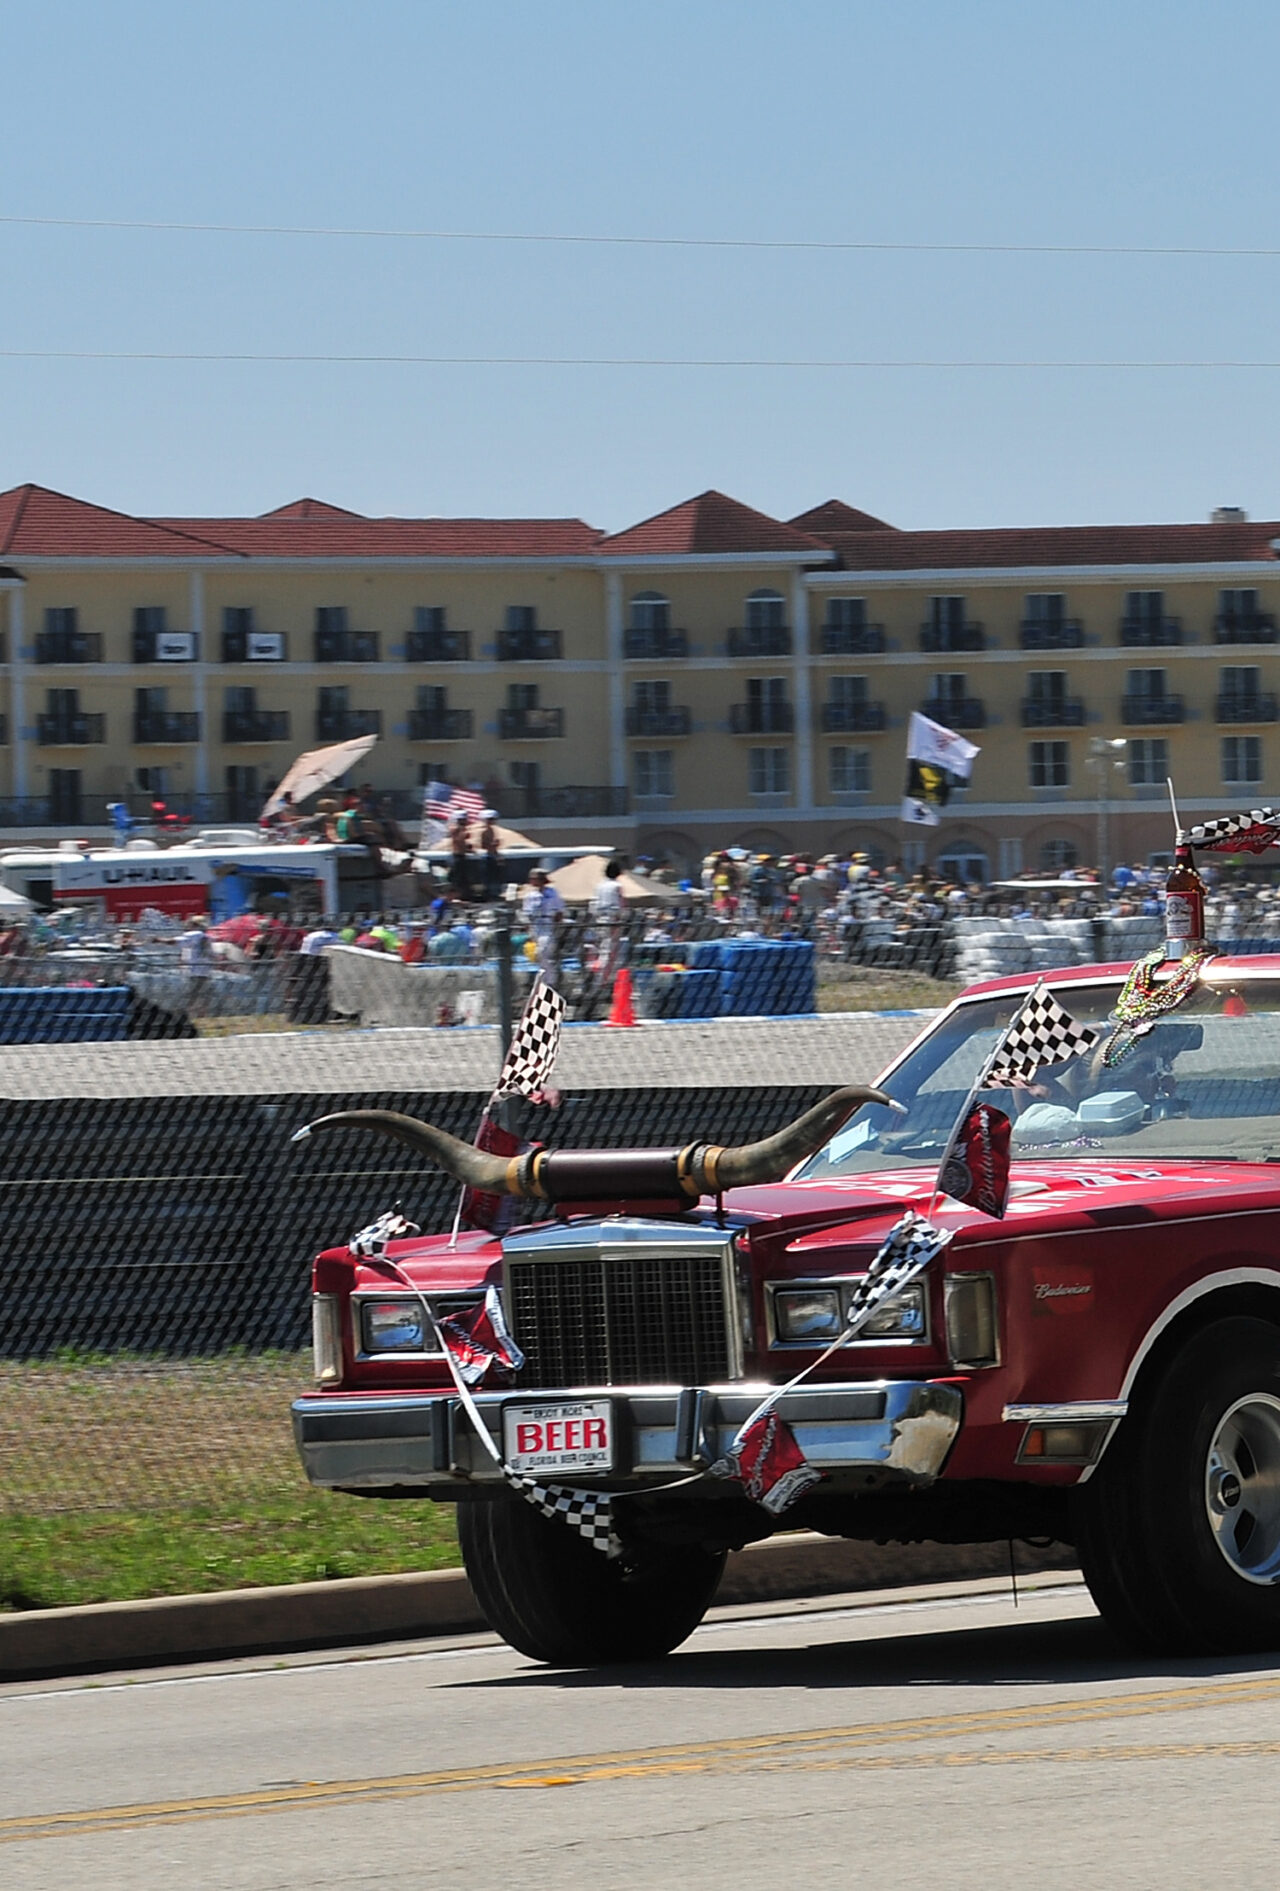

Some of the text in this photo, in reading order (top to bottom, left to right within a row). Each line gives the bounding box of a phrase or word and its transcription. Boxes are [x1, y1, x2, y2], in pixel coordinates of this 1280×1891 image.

[979, 1109, 996, 1211] Budweiser
[1034, 1282, 1091, 1300] Budweiser
[517, 1418, 607, 1453] BEER
[529, 1455, 557, 1466] FLORIDA
[561, 1453, 577, 1464] BEER
[579, 1451, 607, 1462] COUNCIL
